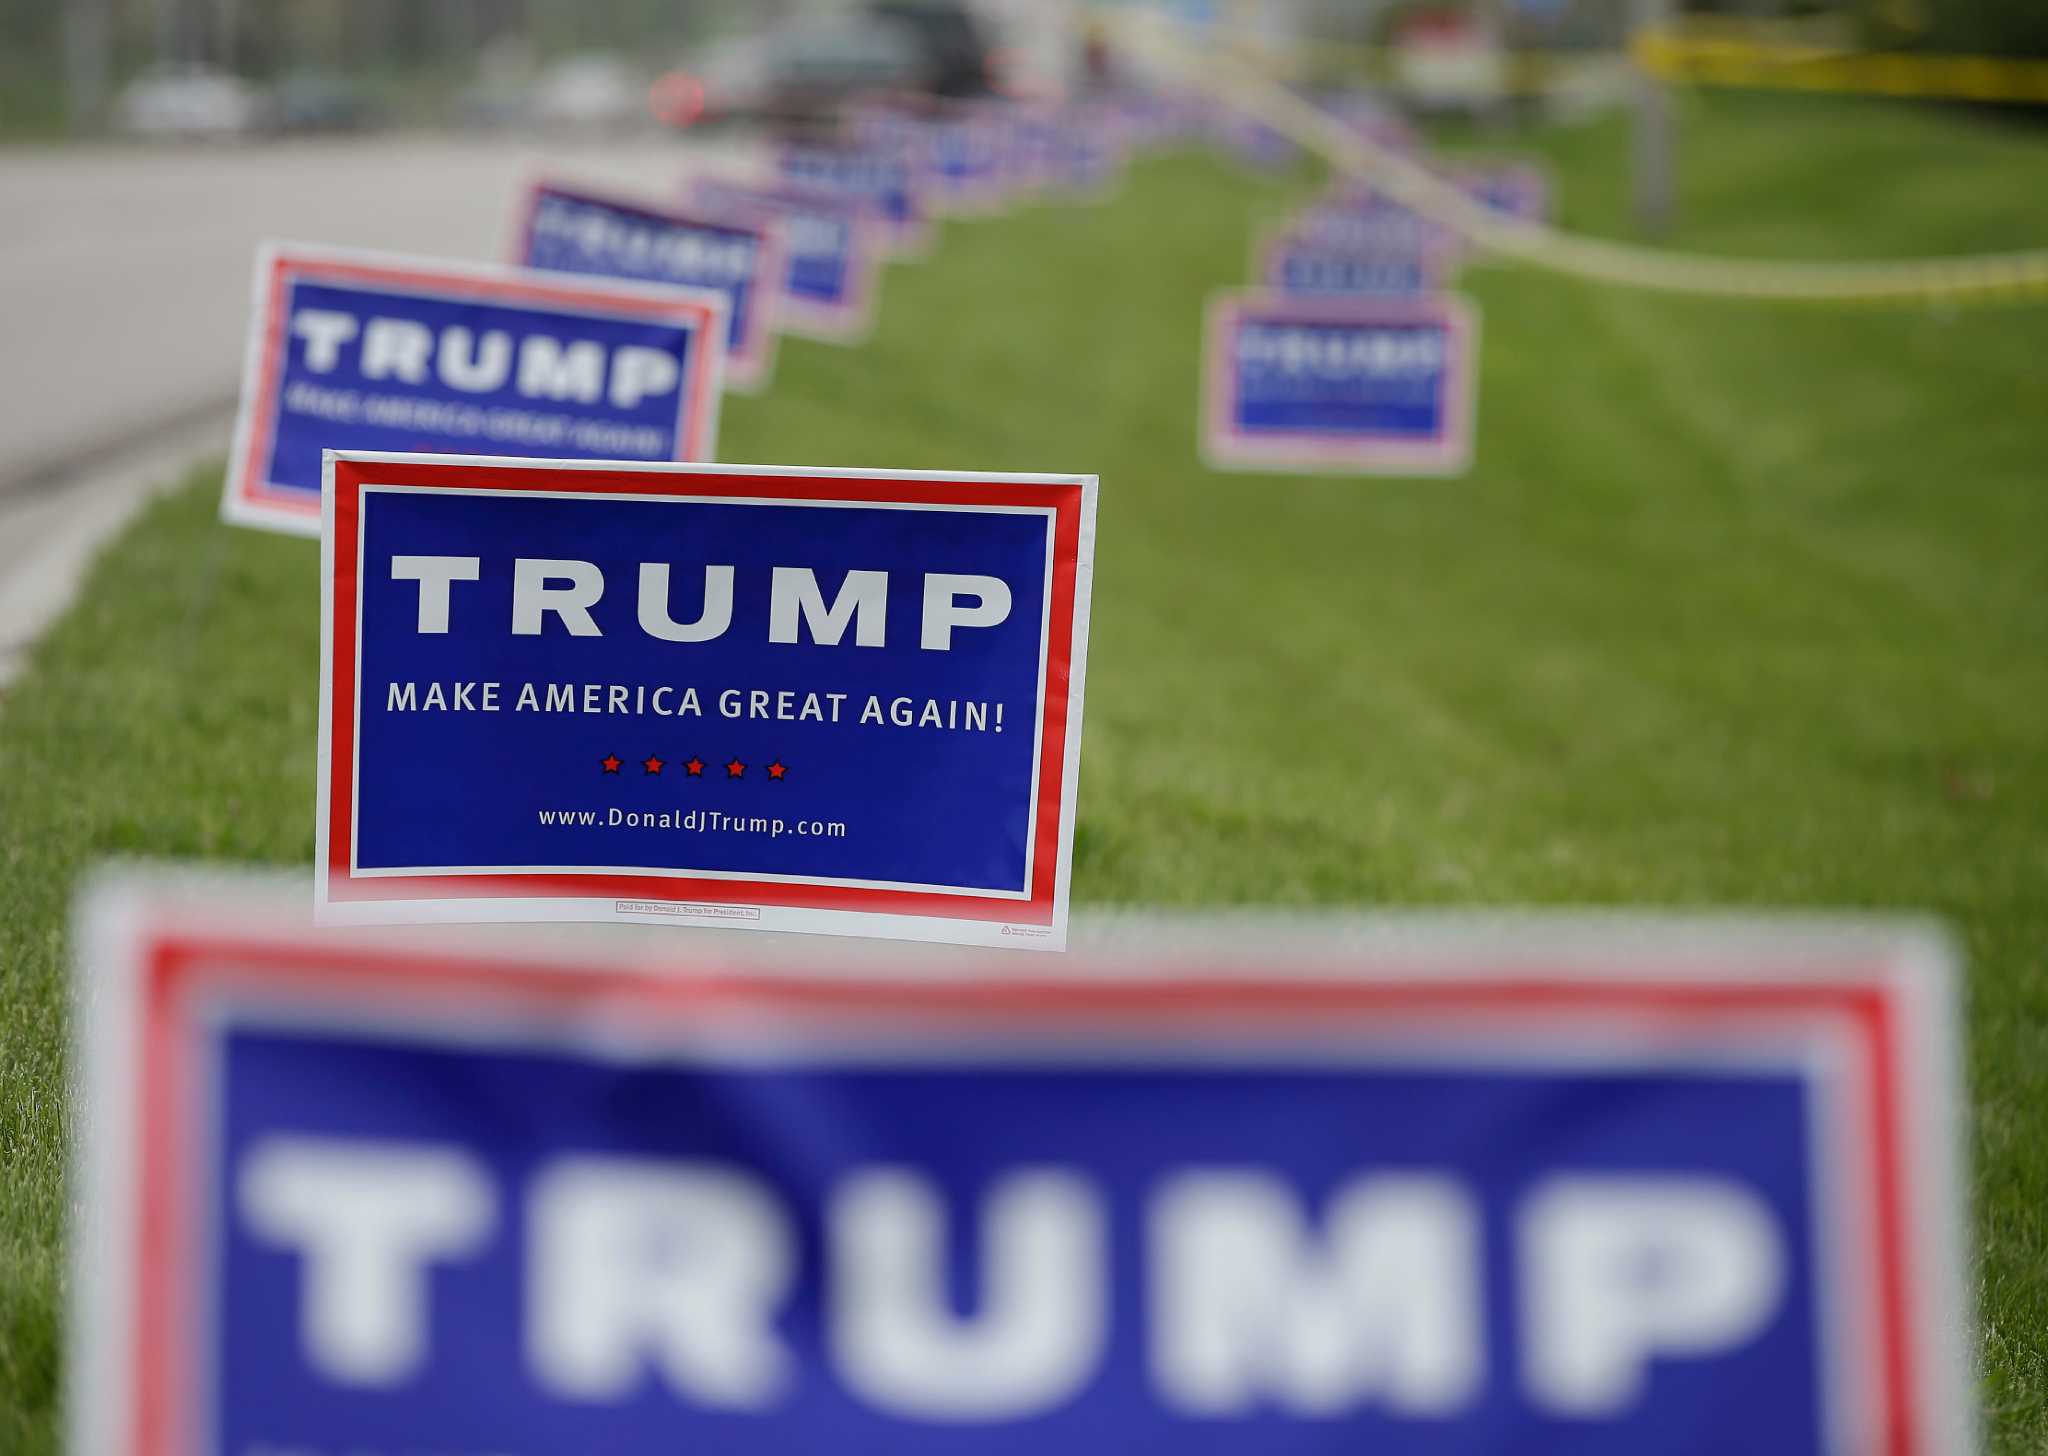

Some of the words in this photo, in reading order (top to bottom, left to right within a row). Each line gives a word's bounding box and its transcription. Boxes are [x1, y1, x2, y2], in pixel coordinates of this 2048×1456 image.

[291, 309, 681, 409] TRUMP
[389, 555, 1013, 651] TRUMP
[387, 682, 500, 712] MAKE
[515, 683, 702, 717] AMERICA
[719, 689, 847, 722] GREAT
[860, 695, 1004, 733] AGAIN!
[538, 807, 847, 838] www.DonaldJTrump.com
[619, 903, 634, 911] Paid
[236, 1134, 1787, 1422] TRUMP
